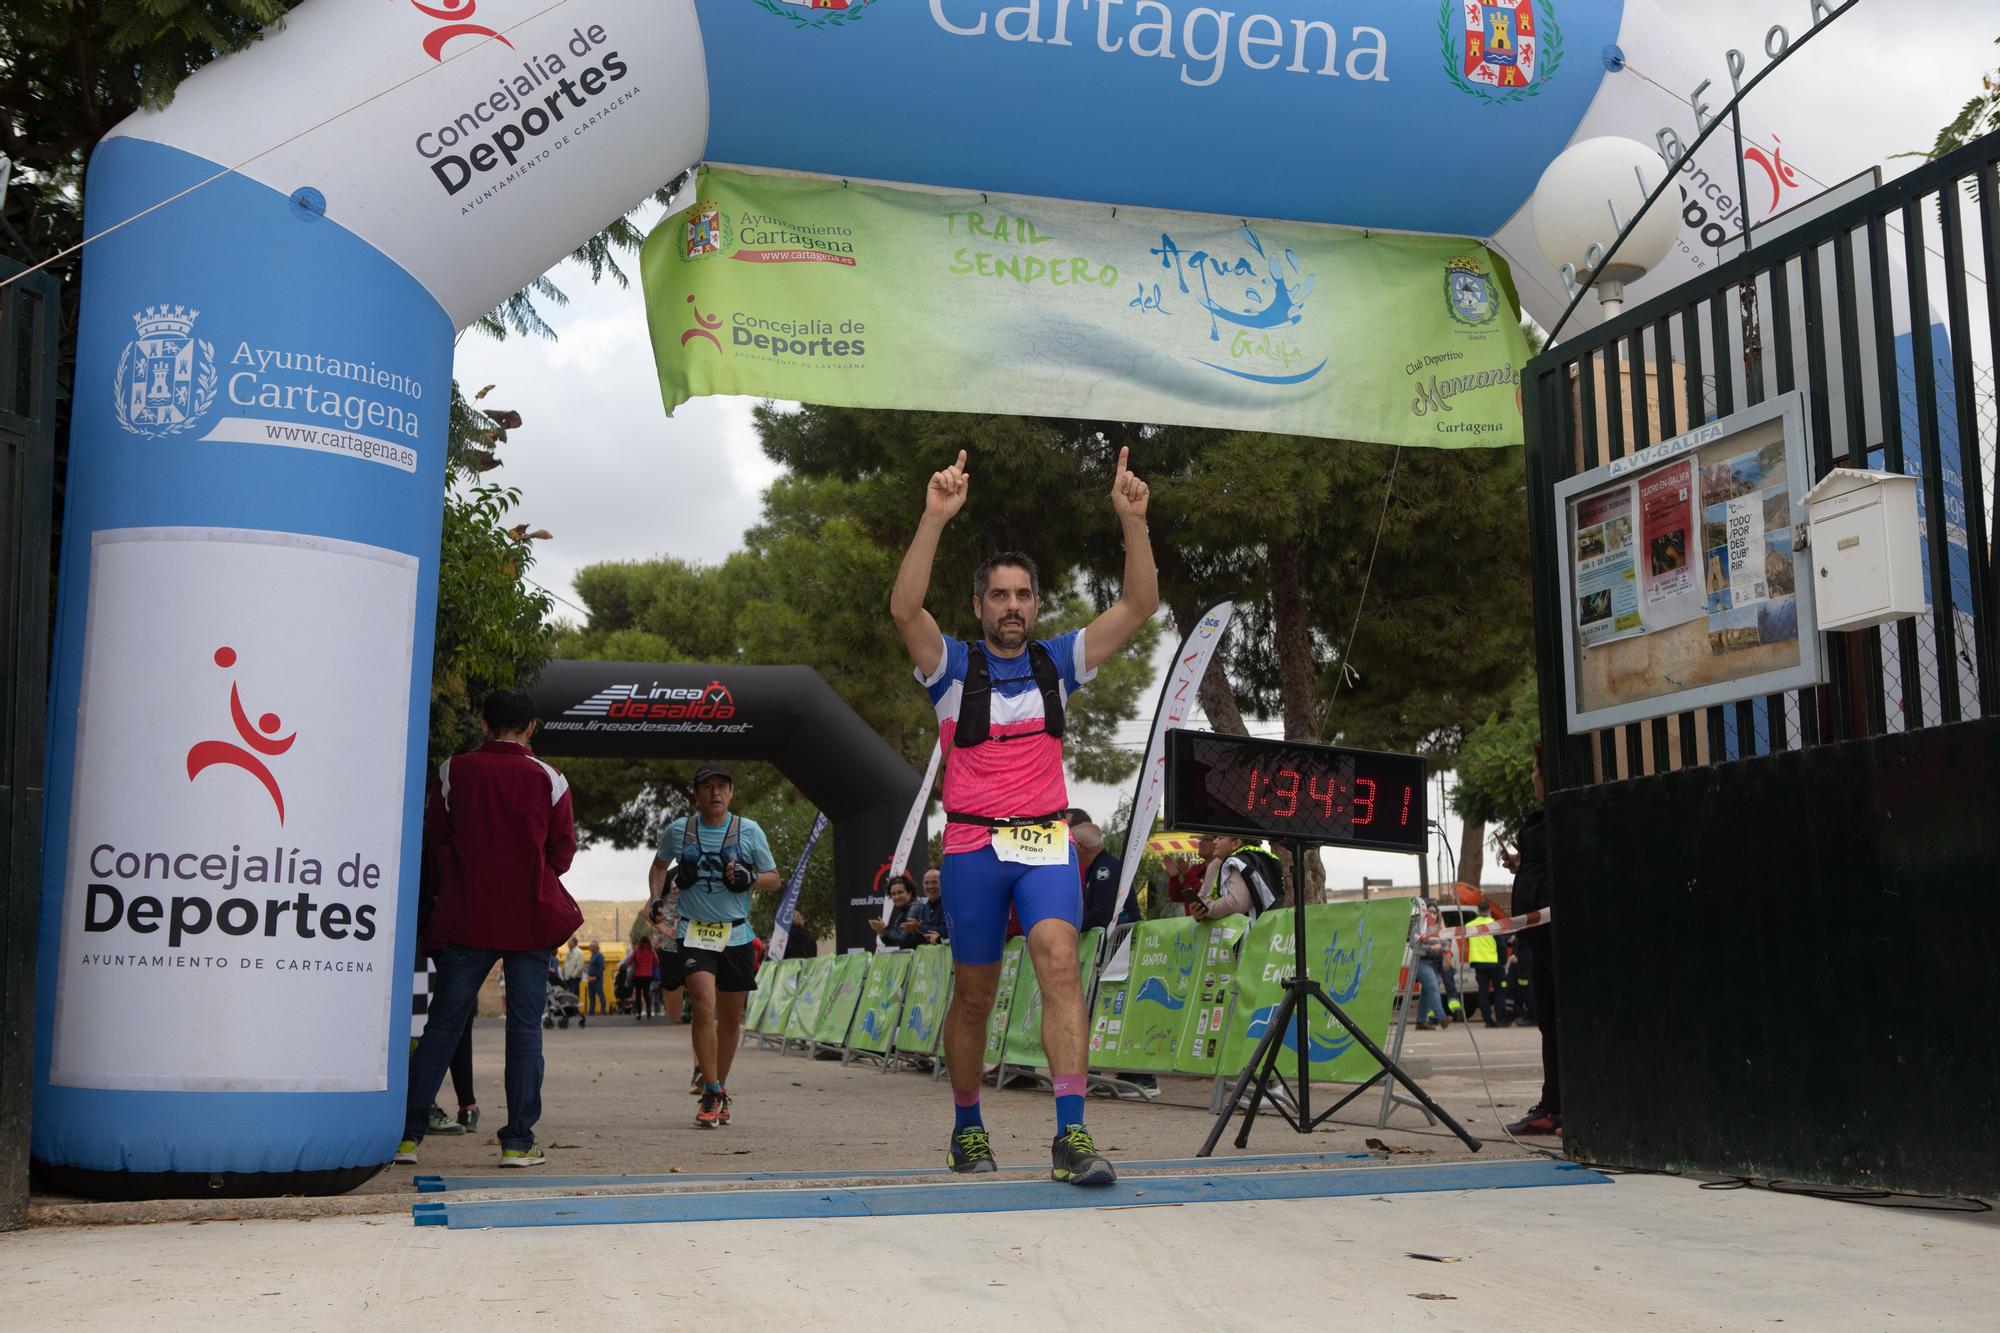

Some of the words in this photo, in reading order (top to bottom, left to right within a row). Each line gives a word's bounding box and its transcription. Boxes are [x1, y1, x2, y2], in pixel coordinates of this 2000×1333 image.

[415, 52, 567, 159] Concejalía
[568, 24, 608, 58] de
[430, 51, 628, 197] Deportes
[460, 149, 551, 216] AYUNTAMIENTO
[554, 135, 571, 151] DE
[573, 85, 642, 137] CARTAGENA
[740, 211, 853, 237] Ayuntamiento
[943, 210, 1056, 245] TRAIL
[739, 227, 854, 254] Cartagena
[760, 250, 854, 266] www.cartagena.es
[948, 246, 1119, 288] SENDERO
[732, 312, 834, 338] Concejalía
[839, 319, 866, 334] de
[732, 326, 866, 357] Deportes
[230, 341, 423, 400] Ayuntamiento
[734, 352, 799, 368] AYUNTAMIENTO
[1405, 360, 1424, 376] Club
[1423, 351, 1464, 369] Deportivo
[228, 371, 420, 438] Cartagena
[1436, 421, 1504, 435] Cartagena
[265, 424, 414, 467] www.cartagena.es
[543, 719, 754, 734] www.lineadesalida.net
[1248, 768, 1413, 827] 1:34:31
[1009, 827, 1053, 845] 1071
[1019, 844, 1044, 853] PEDRO
[89, 843, 323, 891] Concejalía
[336, 852, 381, 889] de
[83, 883, 378, 948] Deportes
[696, 927, 723, 938] 1104
[82, 954, 229, 969] AYUNTAMIENTO
[240, 958, 265, 970] DE
[275, 958, 375, 974] CARTAGENA
